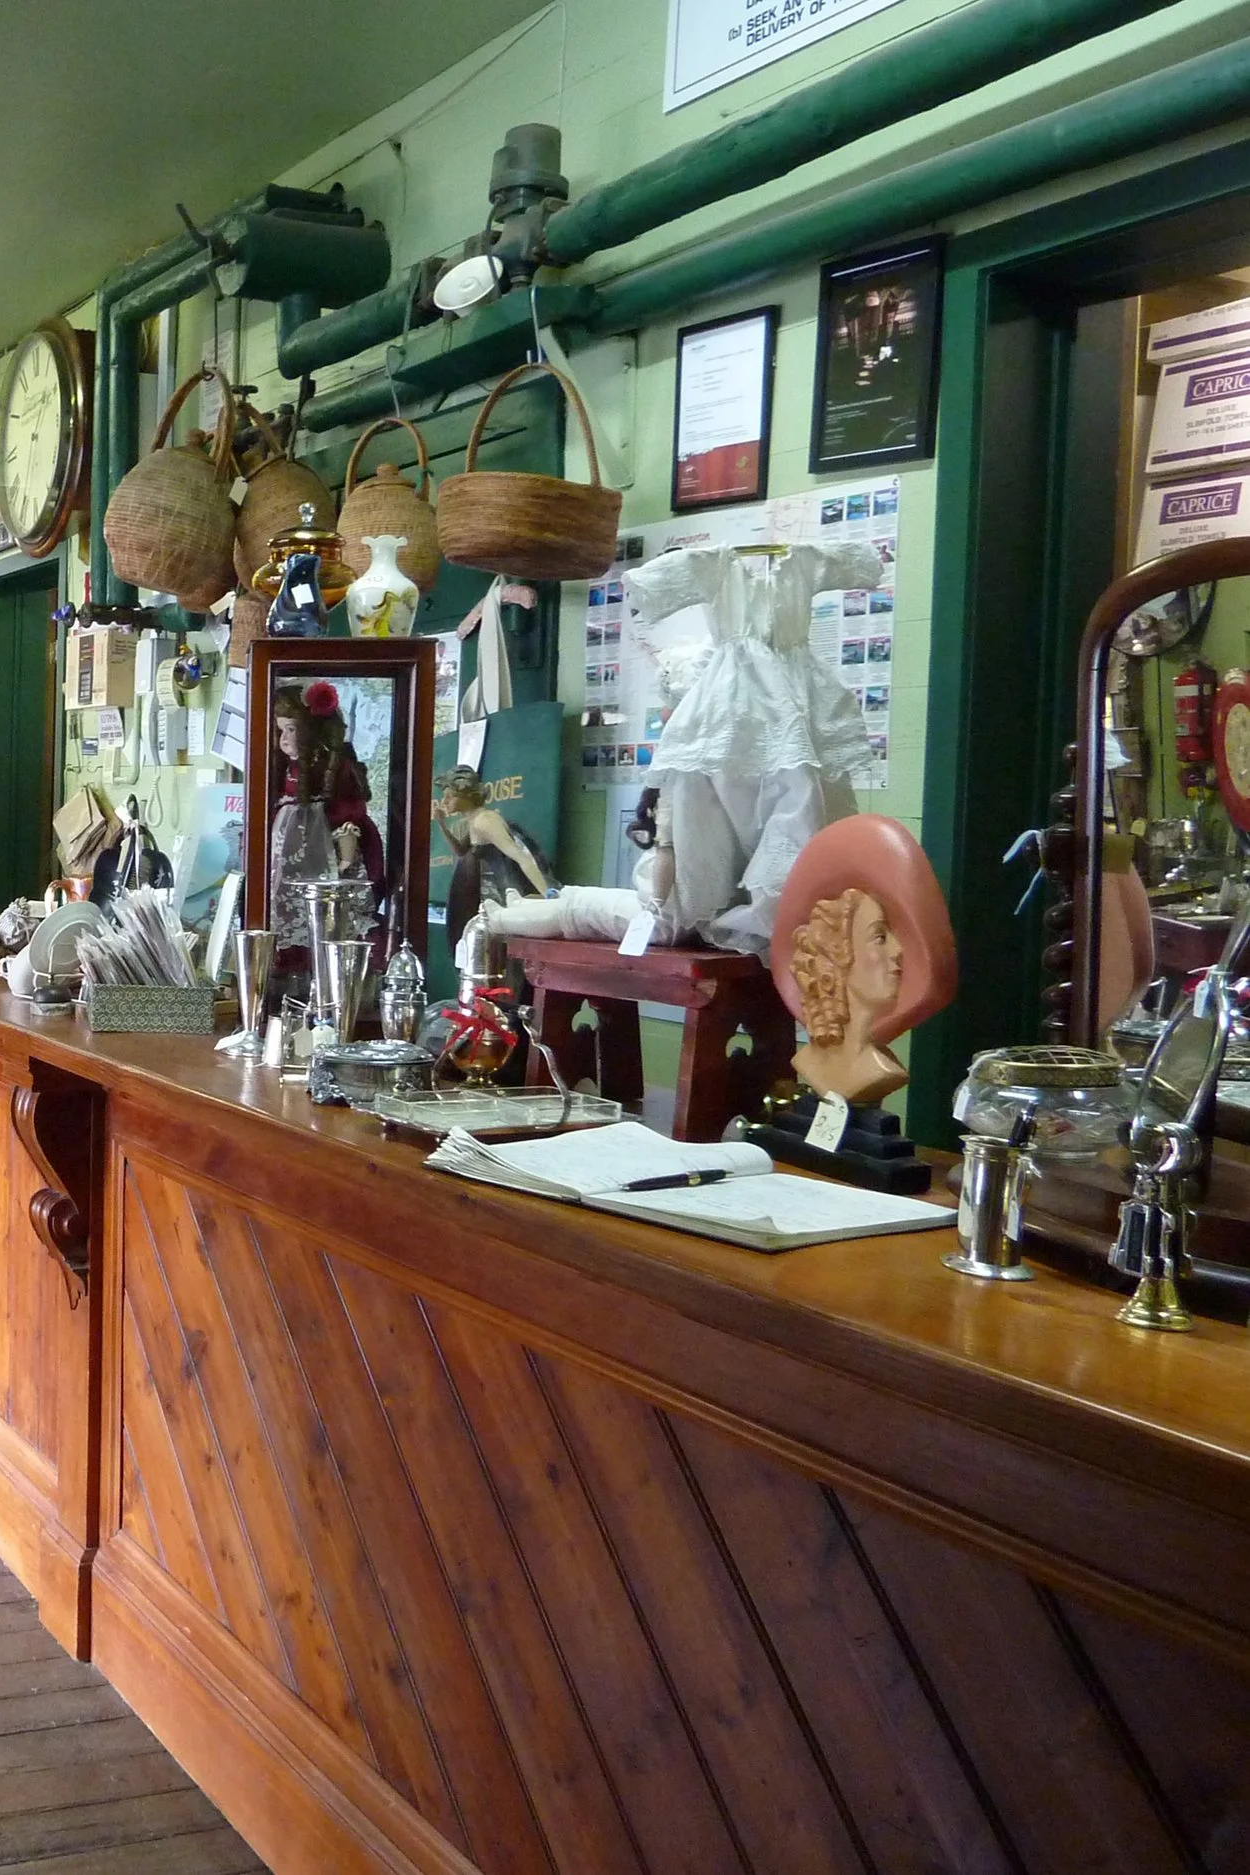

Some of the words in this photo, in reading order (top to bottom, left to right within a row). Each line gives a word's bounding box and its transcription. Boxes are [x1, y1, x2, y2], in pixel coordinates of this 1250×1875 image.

[746, 8, 804, 46] DELIVERY
[747, 5, 777, 31] SEEK
[1166, 491, 1233, 516] CAPRICE
[484, 775, 524, 804] OUSE
